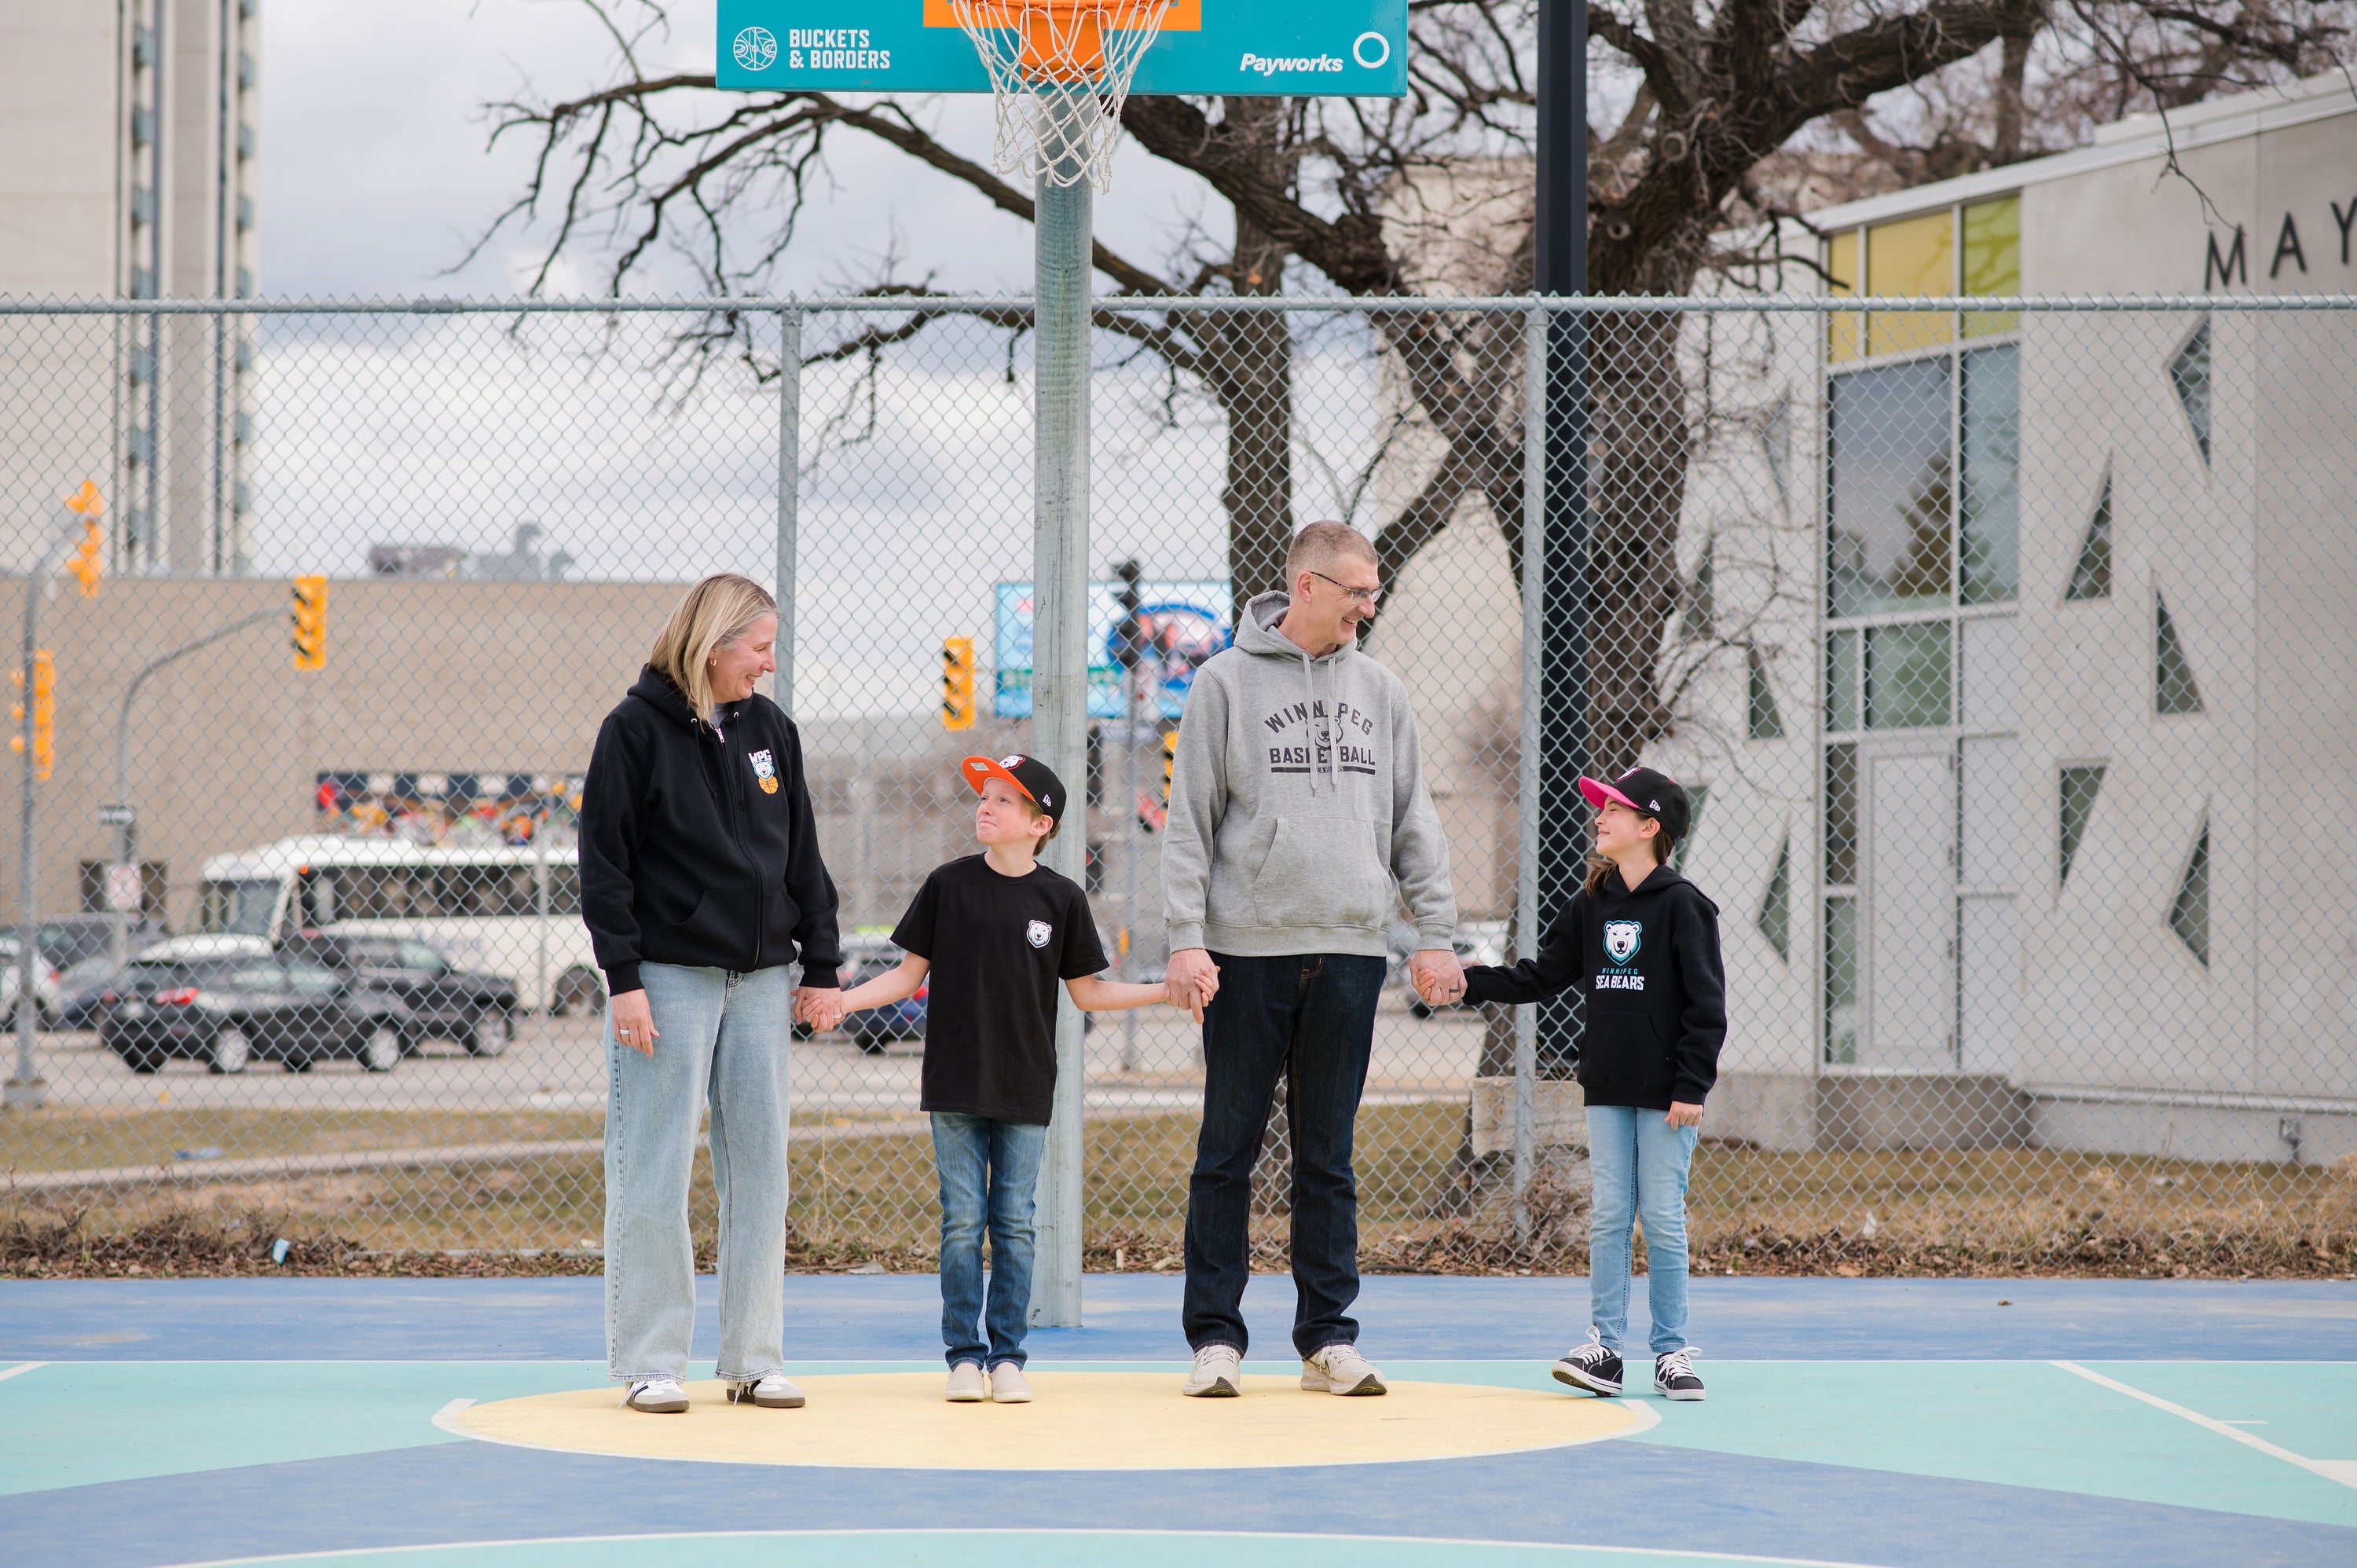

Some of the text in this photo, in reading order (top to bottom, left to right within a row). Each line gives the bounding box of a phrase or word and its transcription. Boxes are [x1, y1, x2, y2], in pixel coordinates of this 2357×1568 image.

[789, 28, 870, 48] BUCKETS
[789, 49, 890, 69] & BORDERS
[1239, 53, 1343, 76] Payworks
[1263, 700, 1373, 736] WINNPEG
[748, 749, 772, 764] WPG
[1269, 746, 1376, 766] BASEBALL
[1596, 975, 1645, 991] SEA BEARS
